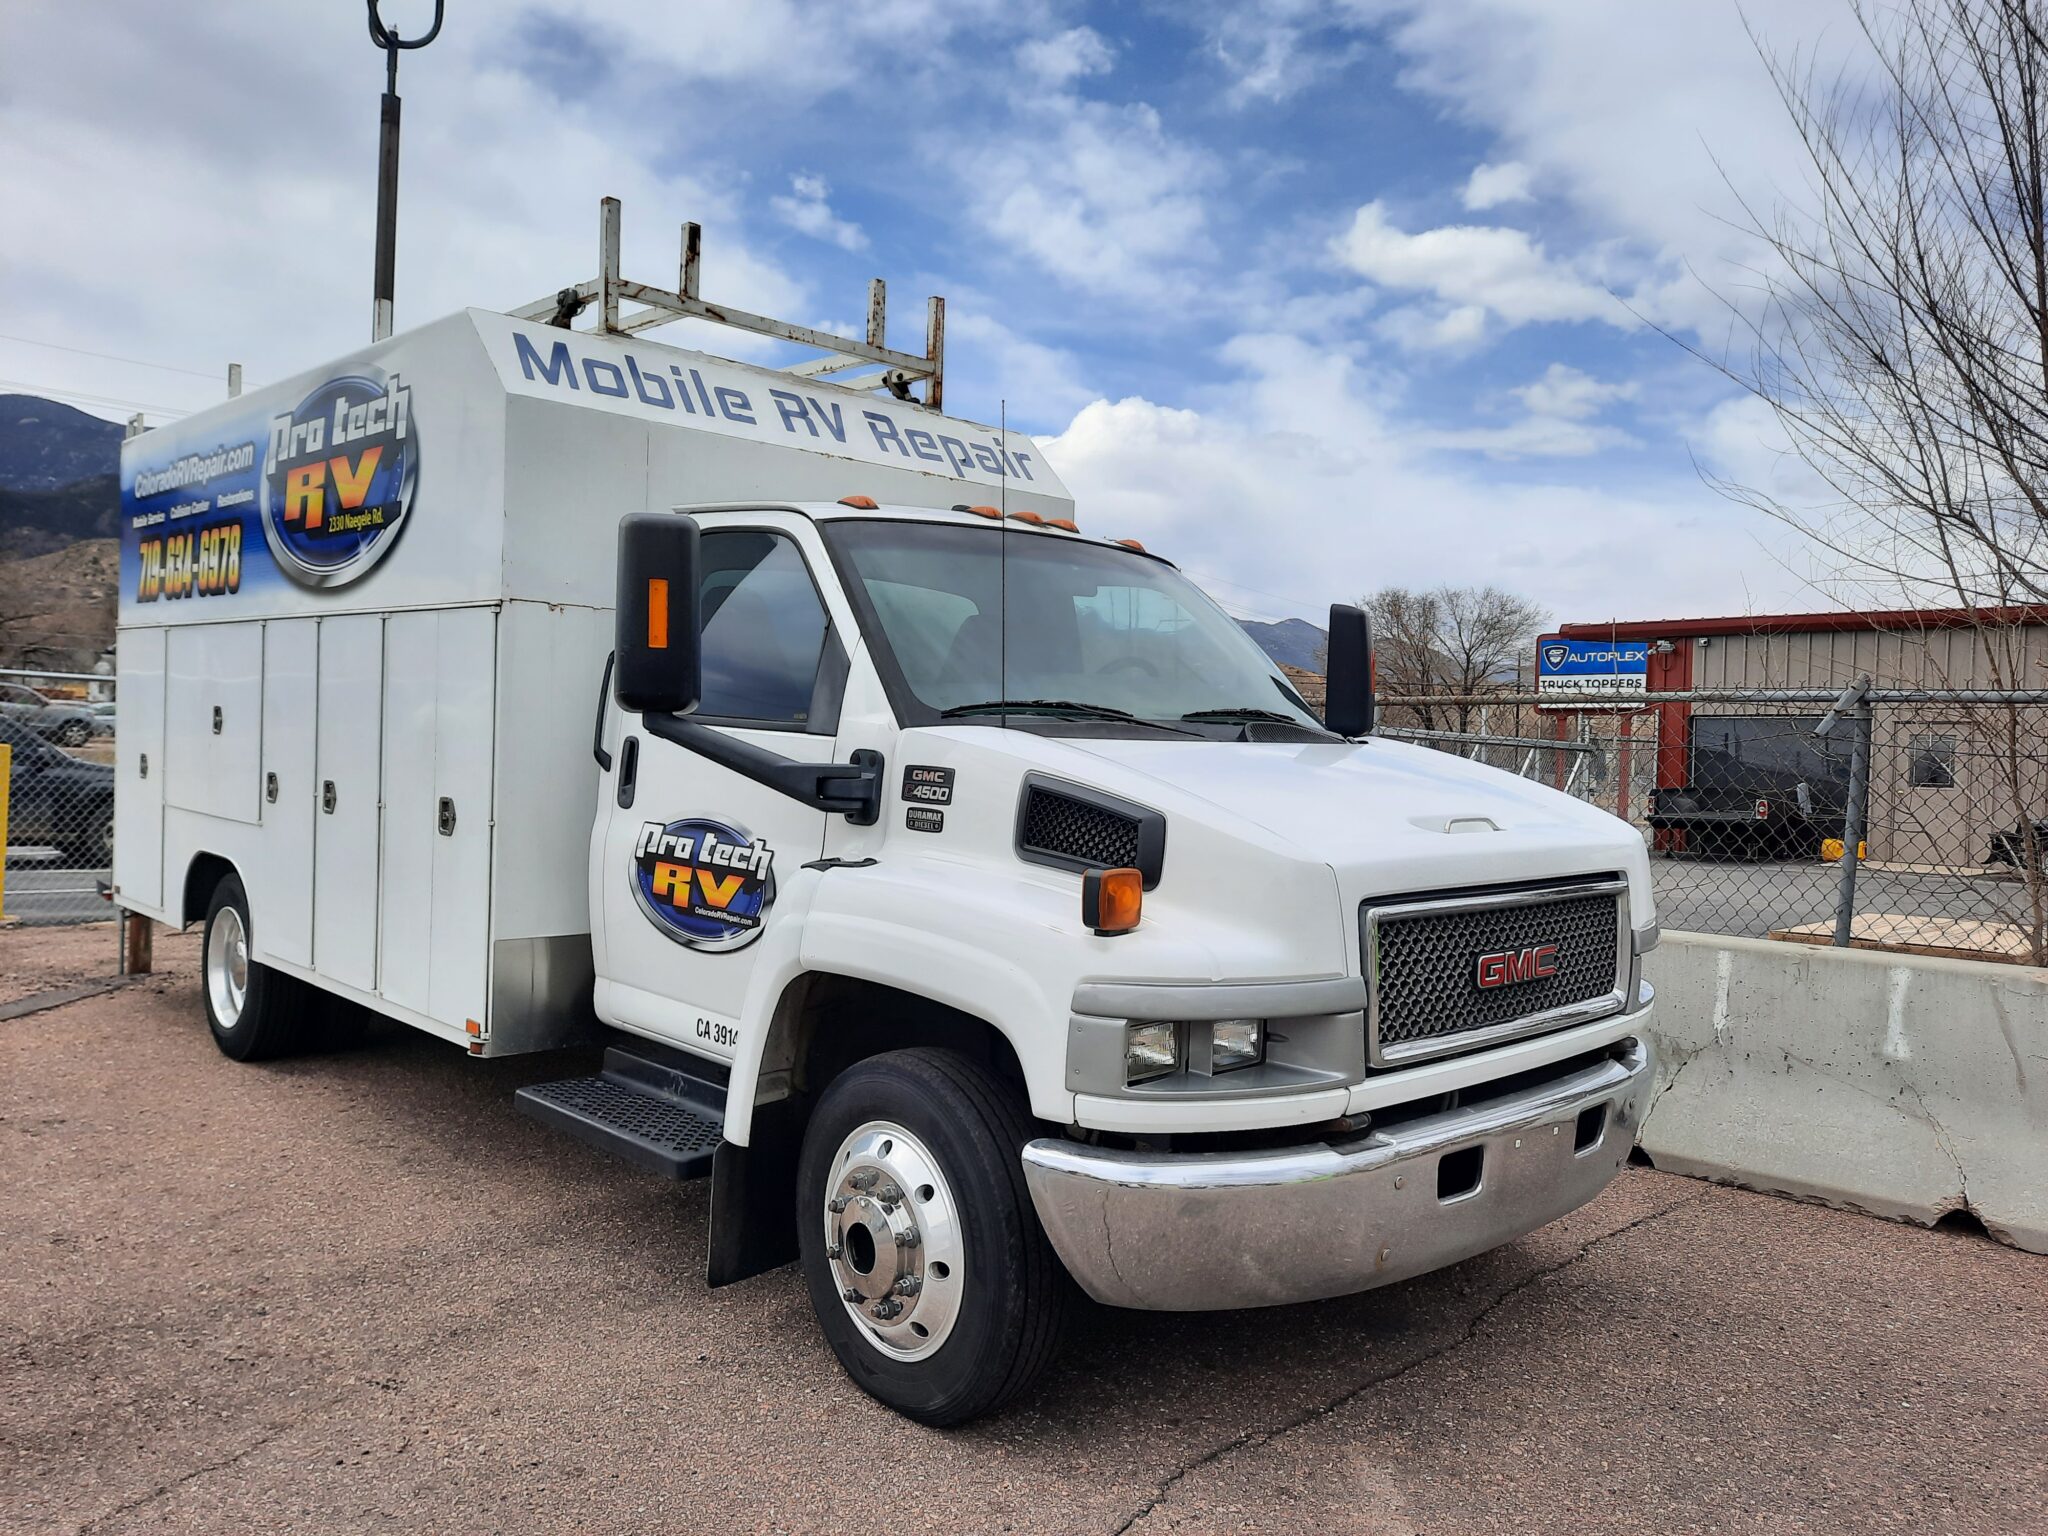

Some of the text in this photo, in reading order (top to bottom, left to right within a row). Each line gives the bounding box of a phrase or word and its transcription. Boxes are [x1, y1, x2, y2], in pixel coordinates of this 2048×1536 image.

[331, 373, 411, 446] tech
[512, 332, 1035, 482] Mobile RV Repair
[134, 443, 254, 499] ColoradoRVRepair.com
[284, 445, 384, 530] RV
[328, 506, 384, 533] 2330 Naegele Rd.
[138, 523, 242, 600] 719-634-6978
[1567, 651, 1646, 663] AUTOPLEX
[1541, 678, 1642, 689] TRUCK TOPPERS
[912, 769, 945, 783] GMC
[908, 809, 942, 821] DURAMAX
[914, 821, 934, 830] DIESEL
[698, 831, 774, 881] tech
[652, 861, 745, 908] RV
[694, 906, 753, 927] ColoradoRVRepair.com
[1477, 943, 1558, 989] GMC
[696, 1017, 711, 1041] CA
